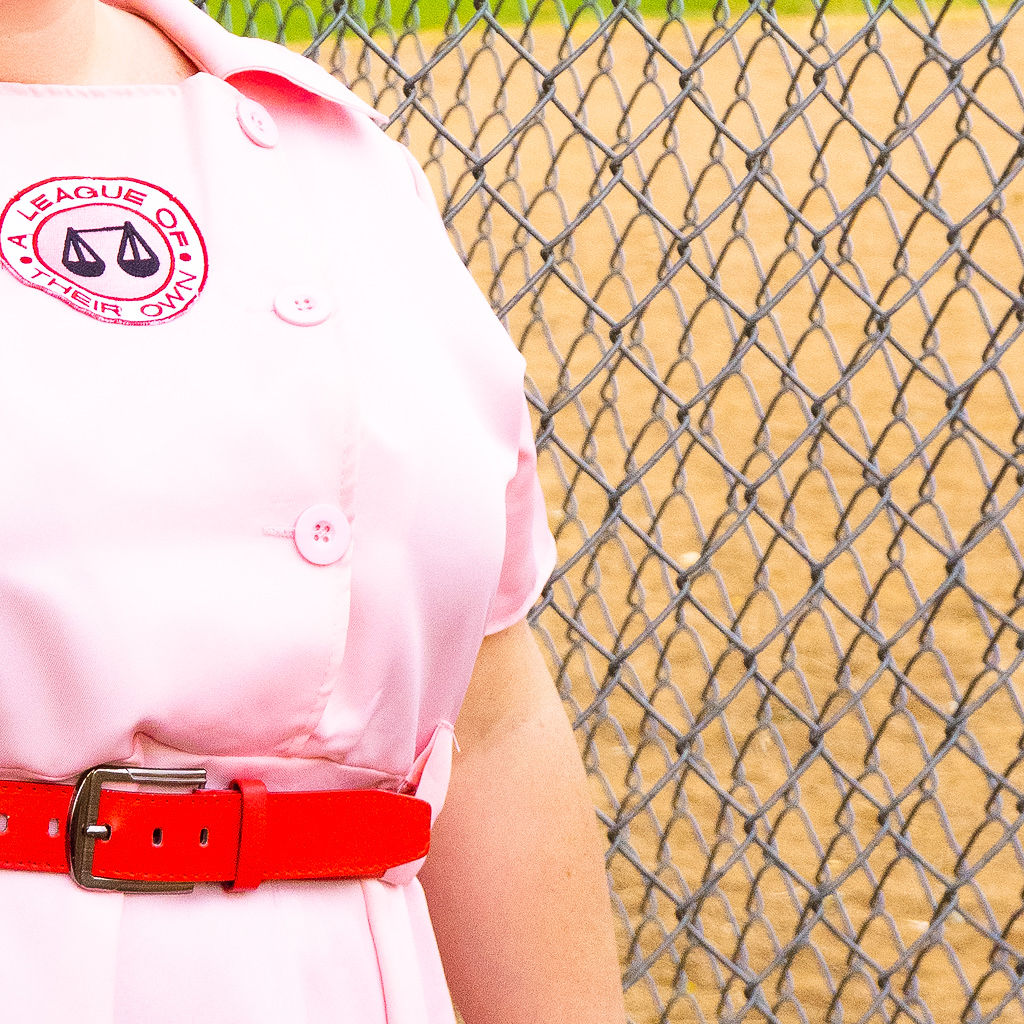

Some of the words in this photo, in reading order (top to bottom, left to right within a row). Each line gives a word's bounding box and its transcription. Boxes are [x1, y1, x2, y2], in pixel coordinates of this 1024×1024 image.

[17, 184, 148, 222] LEAGUE
[7, 233, 28, 249] A
[155, 207, 189, 247] OF
[31, 267, 123, 317] THEIR
[140, 269, 198, 317] OWN
